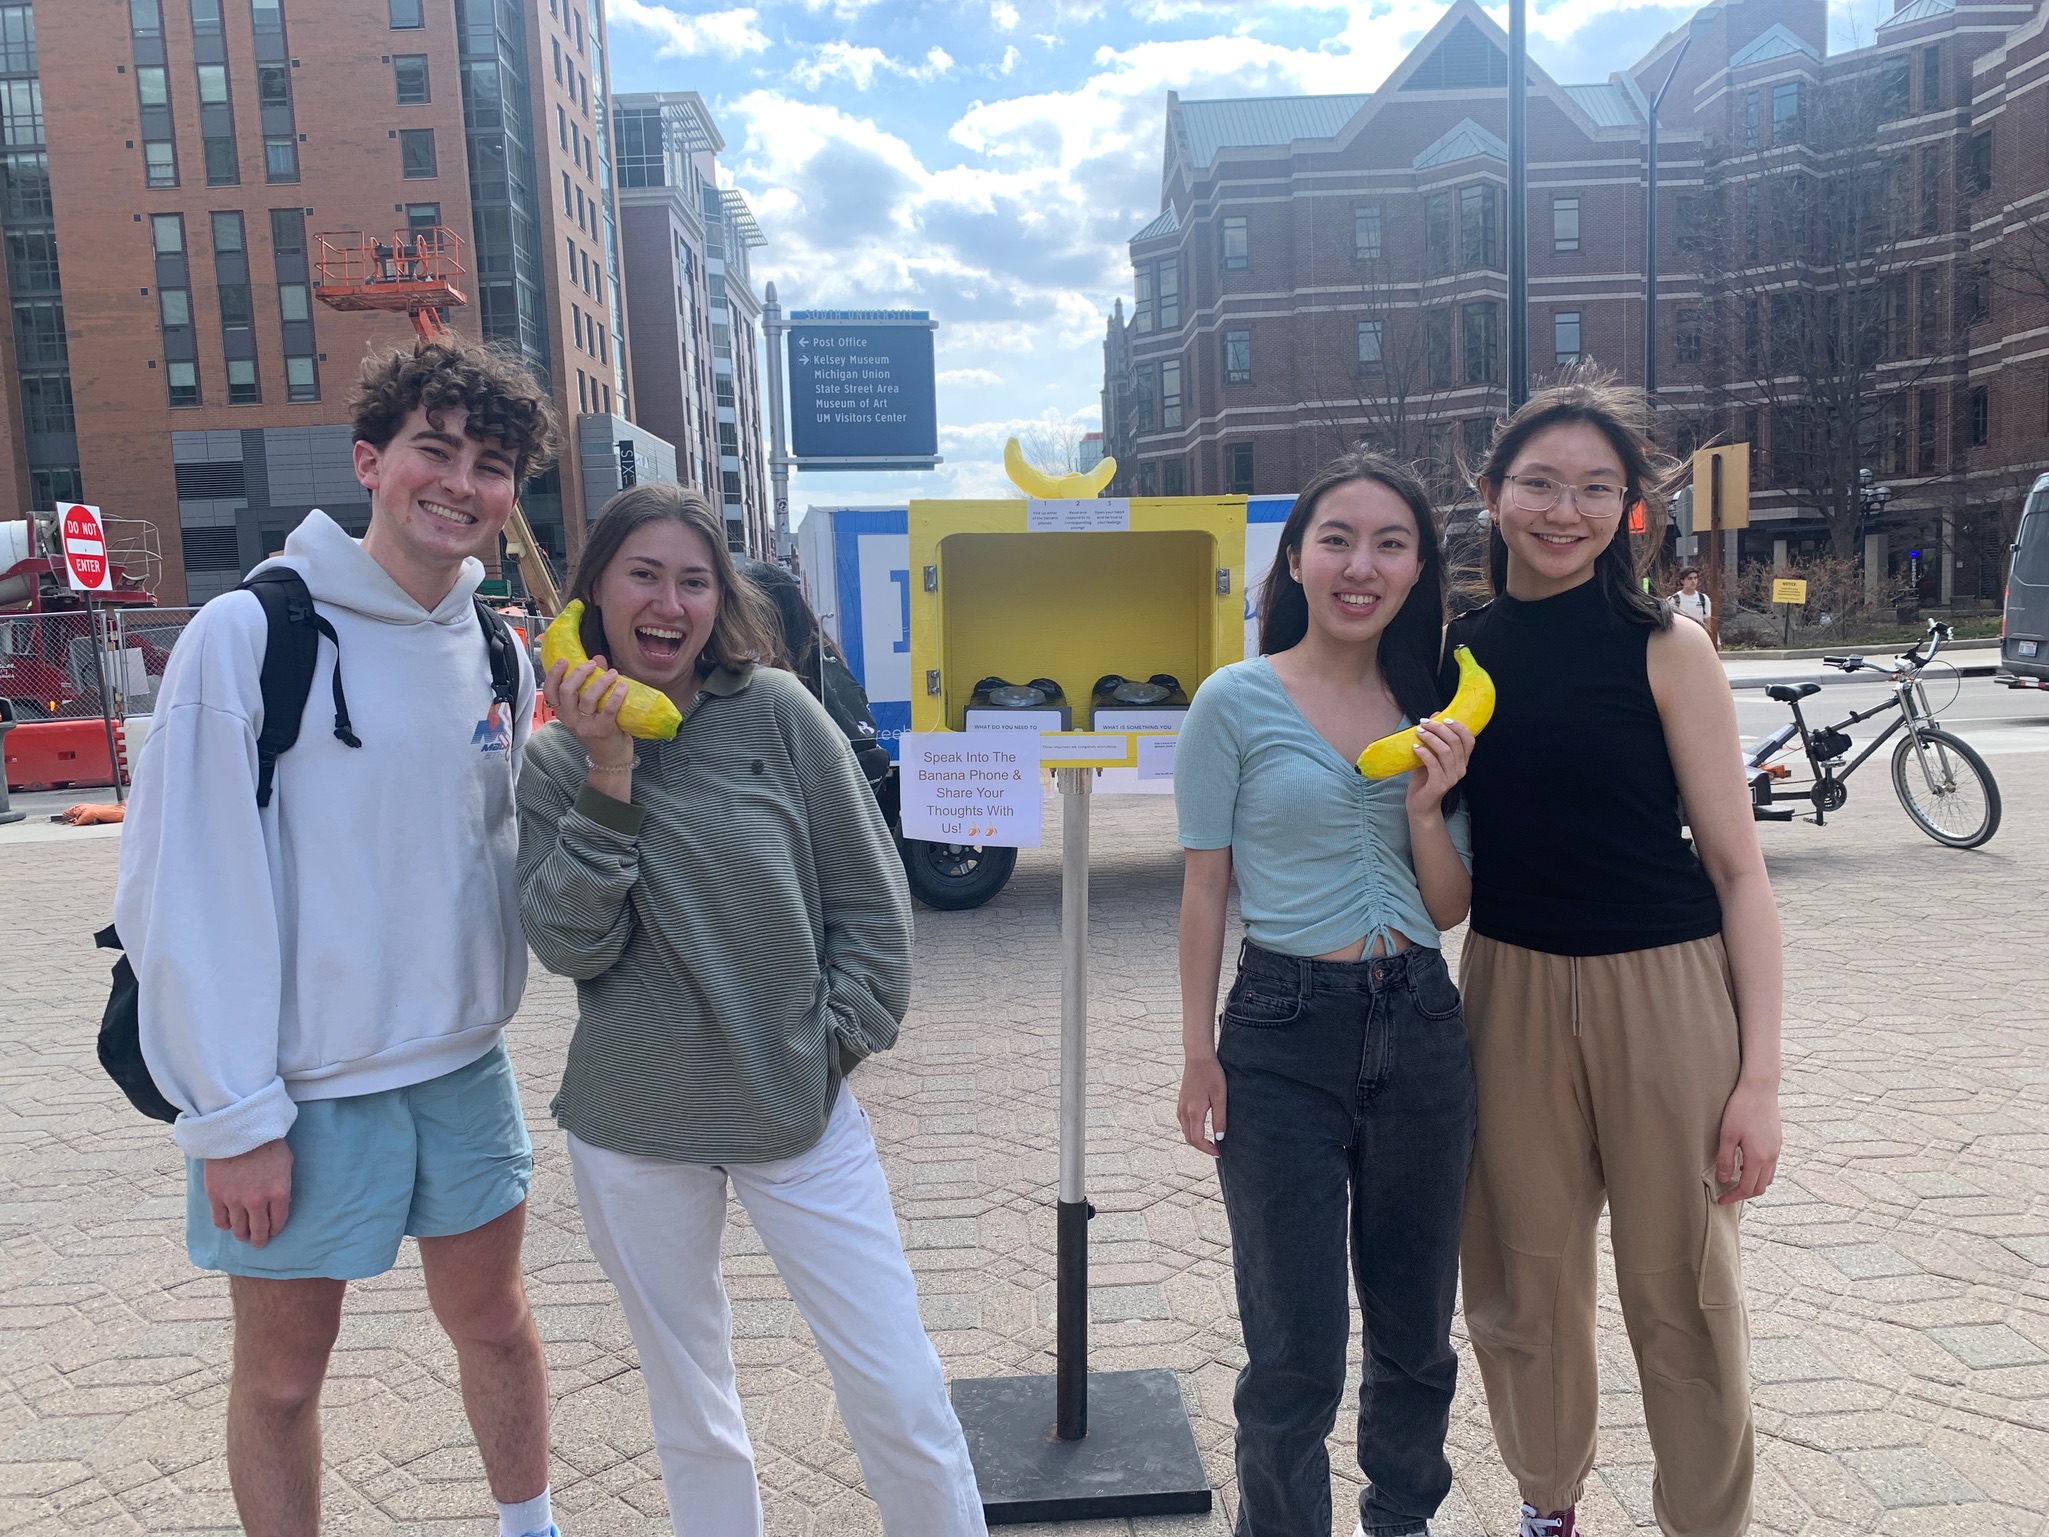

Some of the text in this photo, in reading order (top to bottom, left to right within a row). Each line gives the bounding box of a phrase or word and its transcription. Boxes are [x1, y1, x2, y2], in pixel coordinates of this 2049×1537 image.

[813, 337, 868, 347] Post Office
[813, 355, 890, 366] Kelsey Museum
[814, 369, 891, 381] Michigan Union
[815, 384, 900, 394] State Street Area
[816, 399, 888, 408] Museum of Art
[816, 412, 907, 423] UM Visitors Center
[67, 520, 97, 536] DO NOT
[75, 558, 101, 573] ENTER
[923, 751, 1017, 765] Speak Into The
[918, 769, 1022, 780] Banana Phone &
[936, 787, 1004, 798] Share Your
[926, 804, 1014, 819] Thoughts With
[941, 823, 962, 833] Us!
